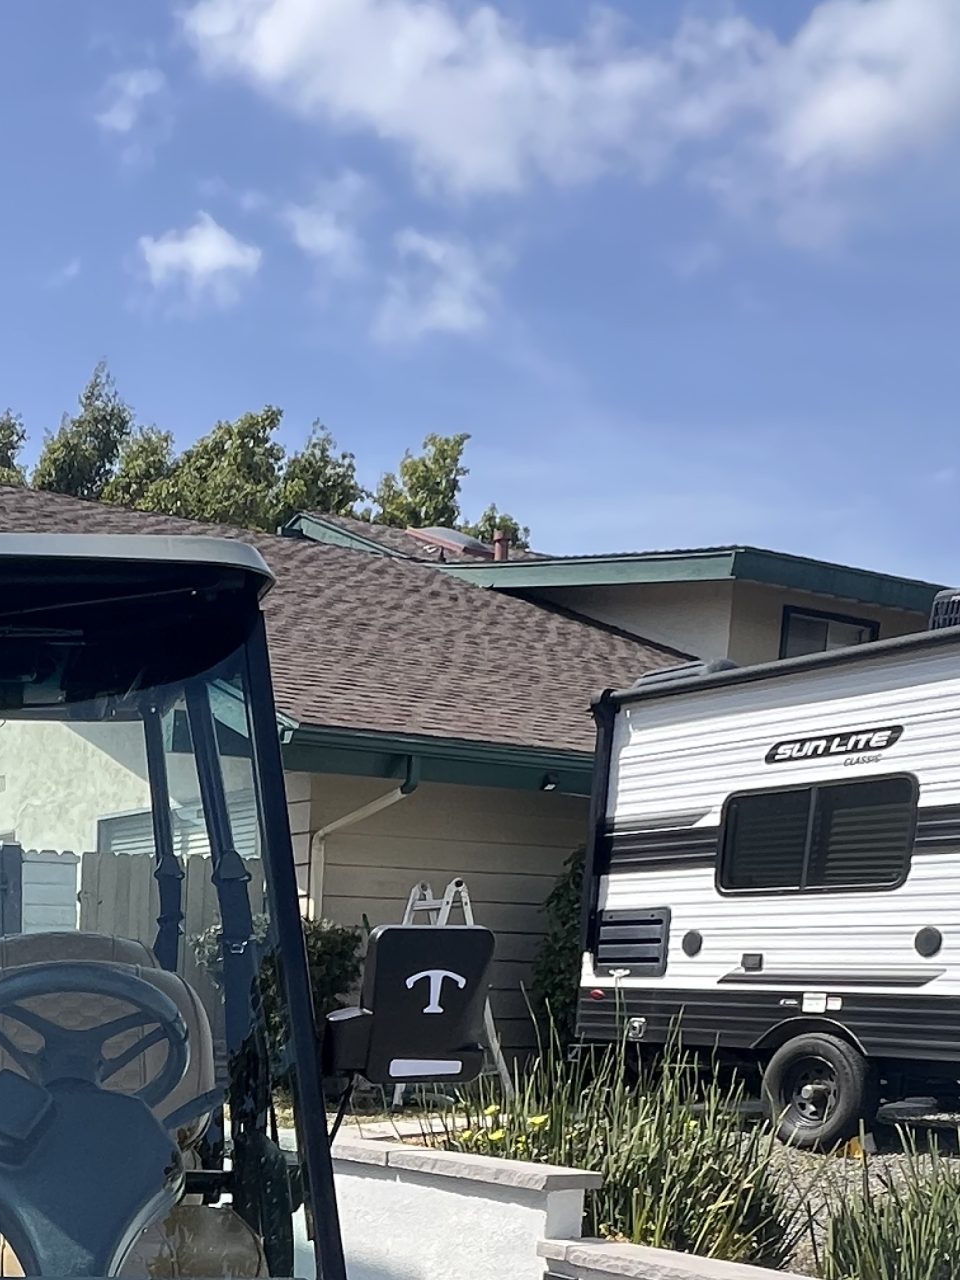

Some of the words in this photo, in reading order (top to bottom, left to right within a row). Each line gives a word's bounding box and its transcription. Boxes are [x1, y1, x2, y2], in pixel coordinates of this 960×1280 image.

[774, 739, 827, 760] SUN
[830, 730, 892, 753] LITE
[843, 754, 882, 766] CLASSIC
[405, 969, 466, 1013] T
